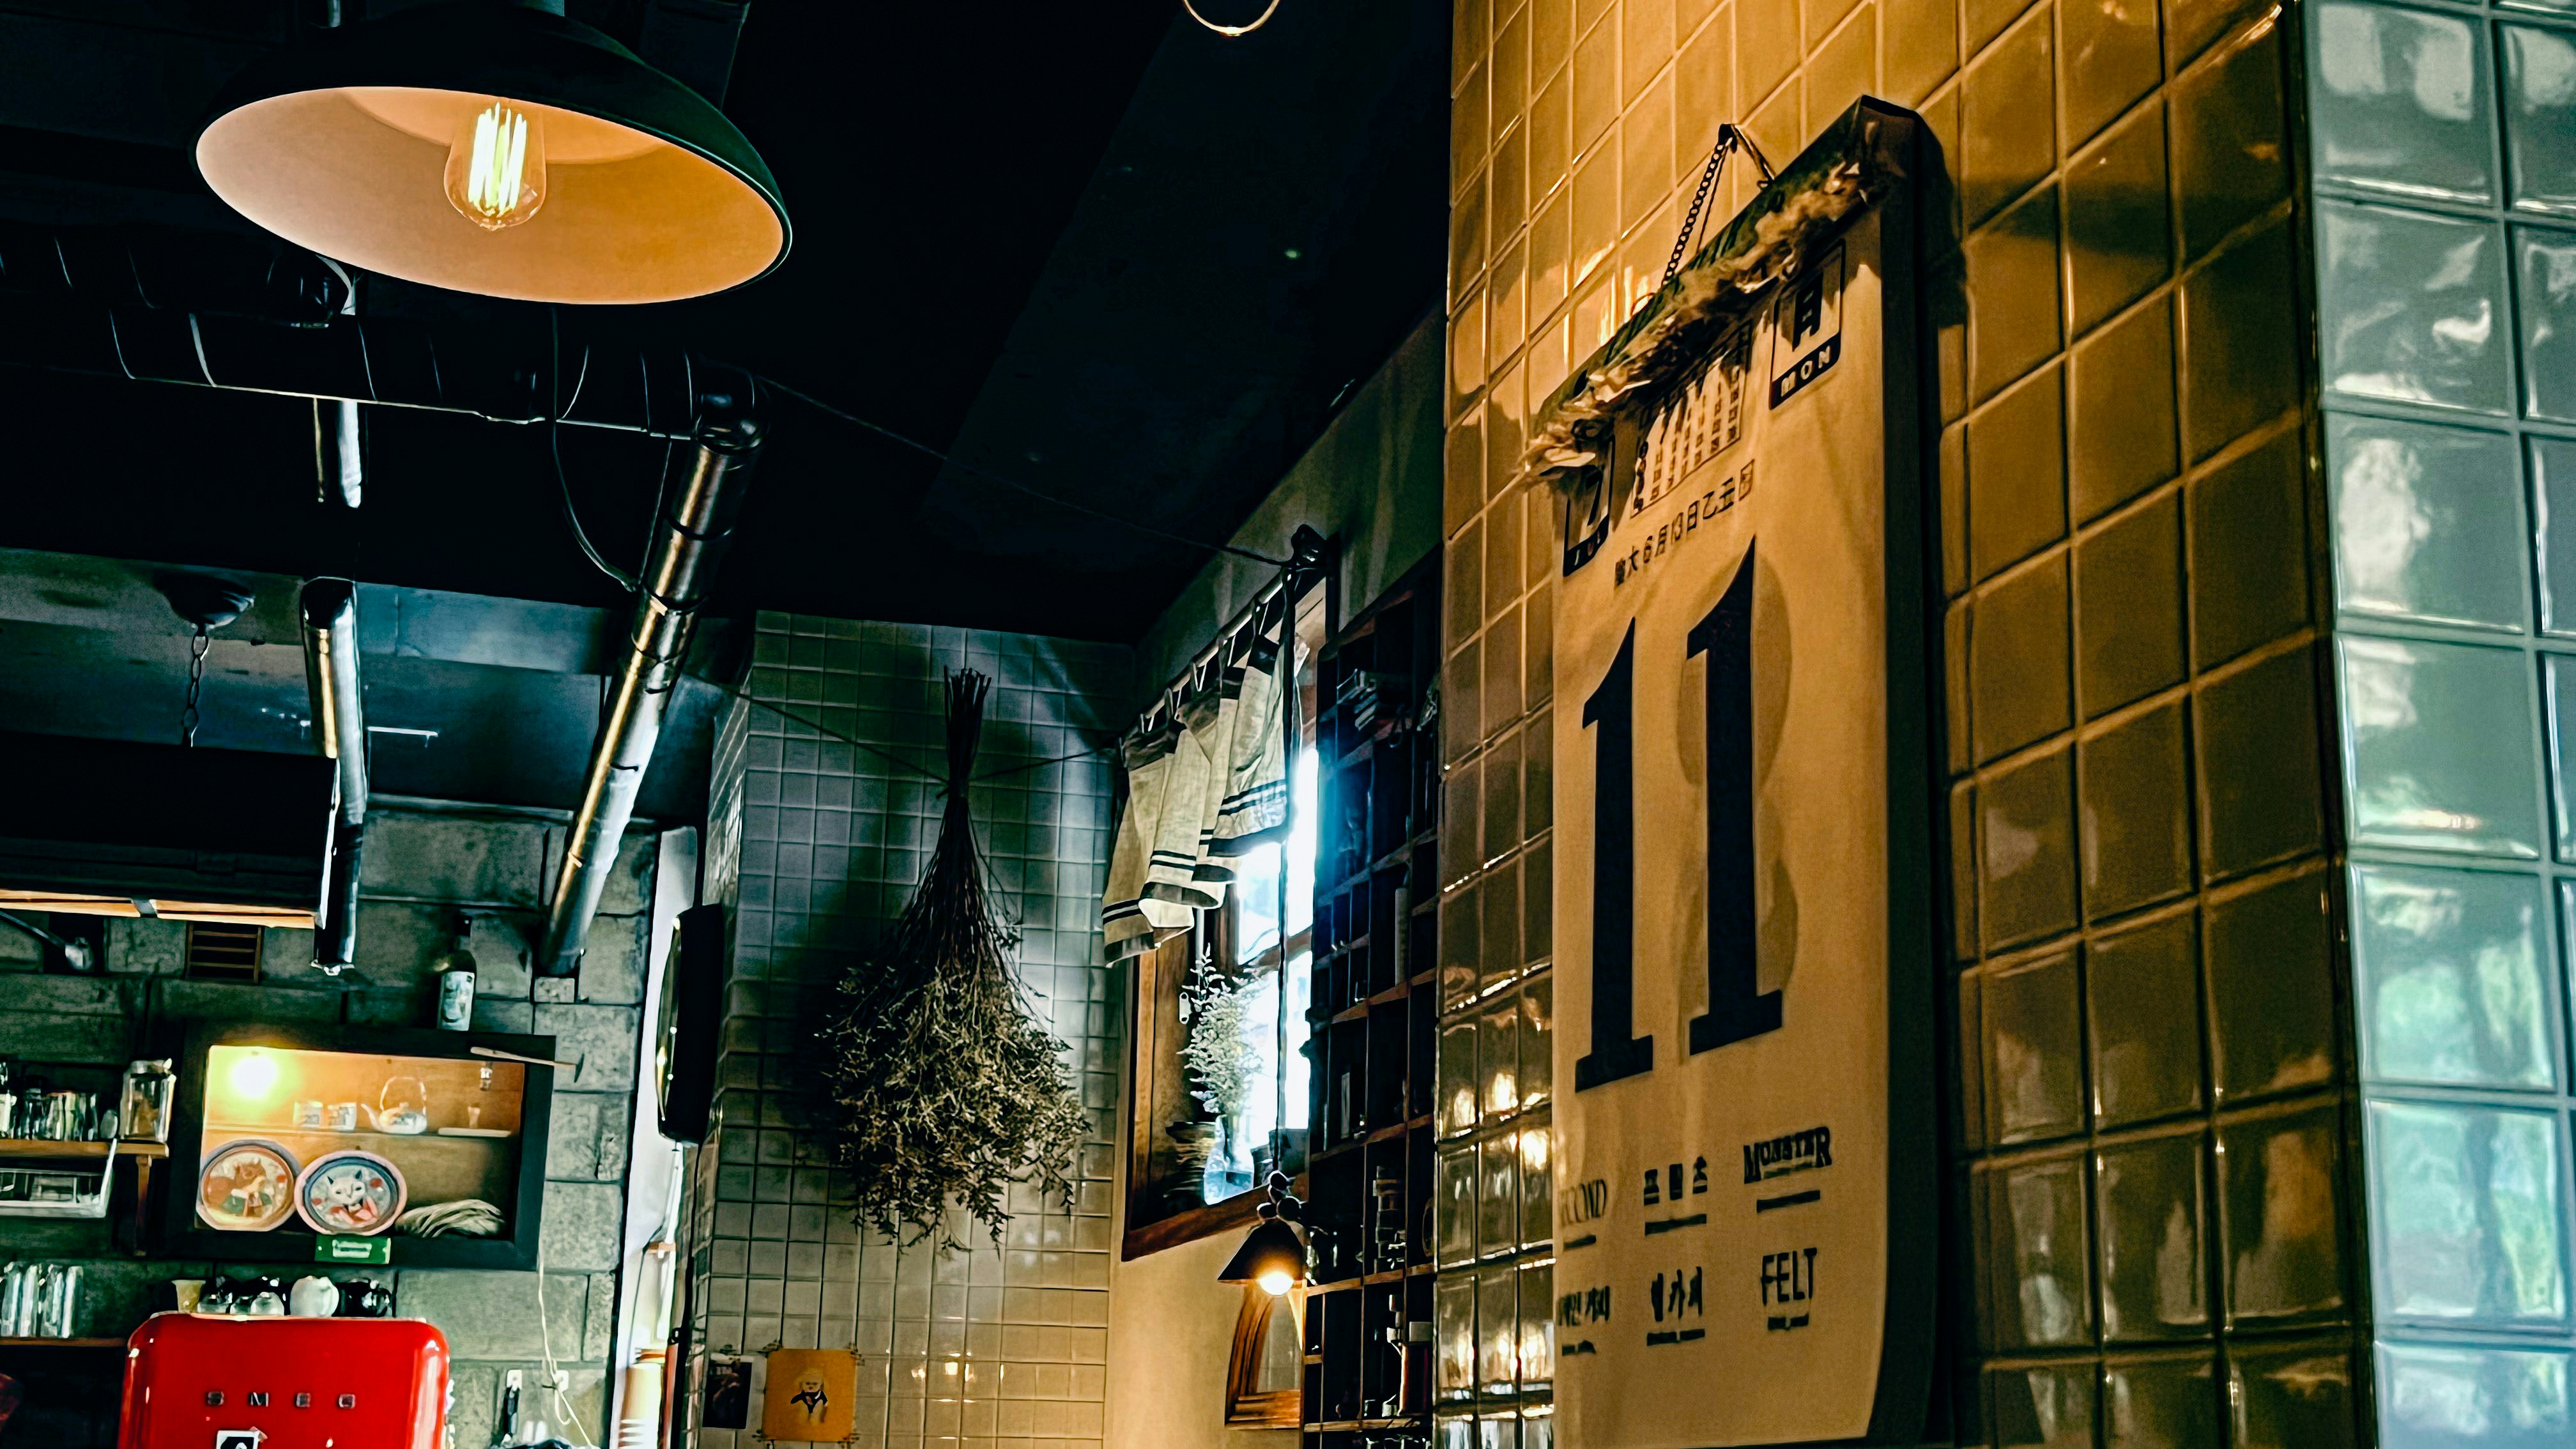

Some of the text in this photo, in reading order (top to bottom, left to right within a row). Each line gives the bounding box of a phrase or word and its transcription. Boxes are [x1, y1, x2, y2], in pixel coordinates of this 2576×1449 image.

[1781, 345, 1832, 397] MON
[1575, 534, 1782, 1092] 11
[1761, 1247, 1818, 1307] FELT
